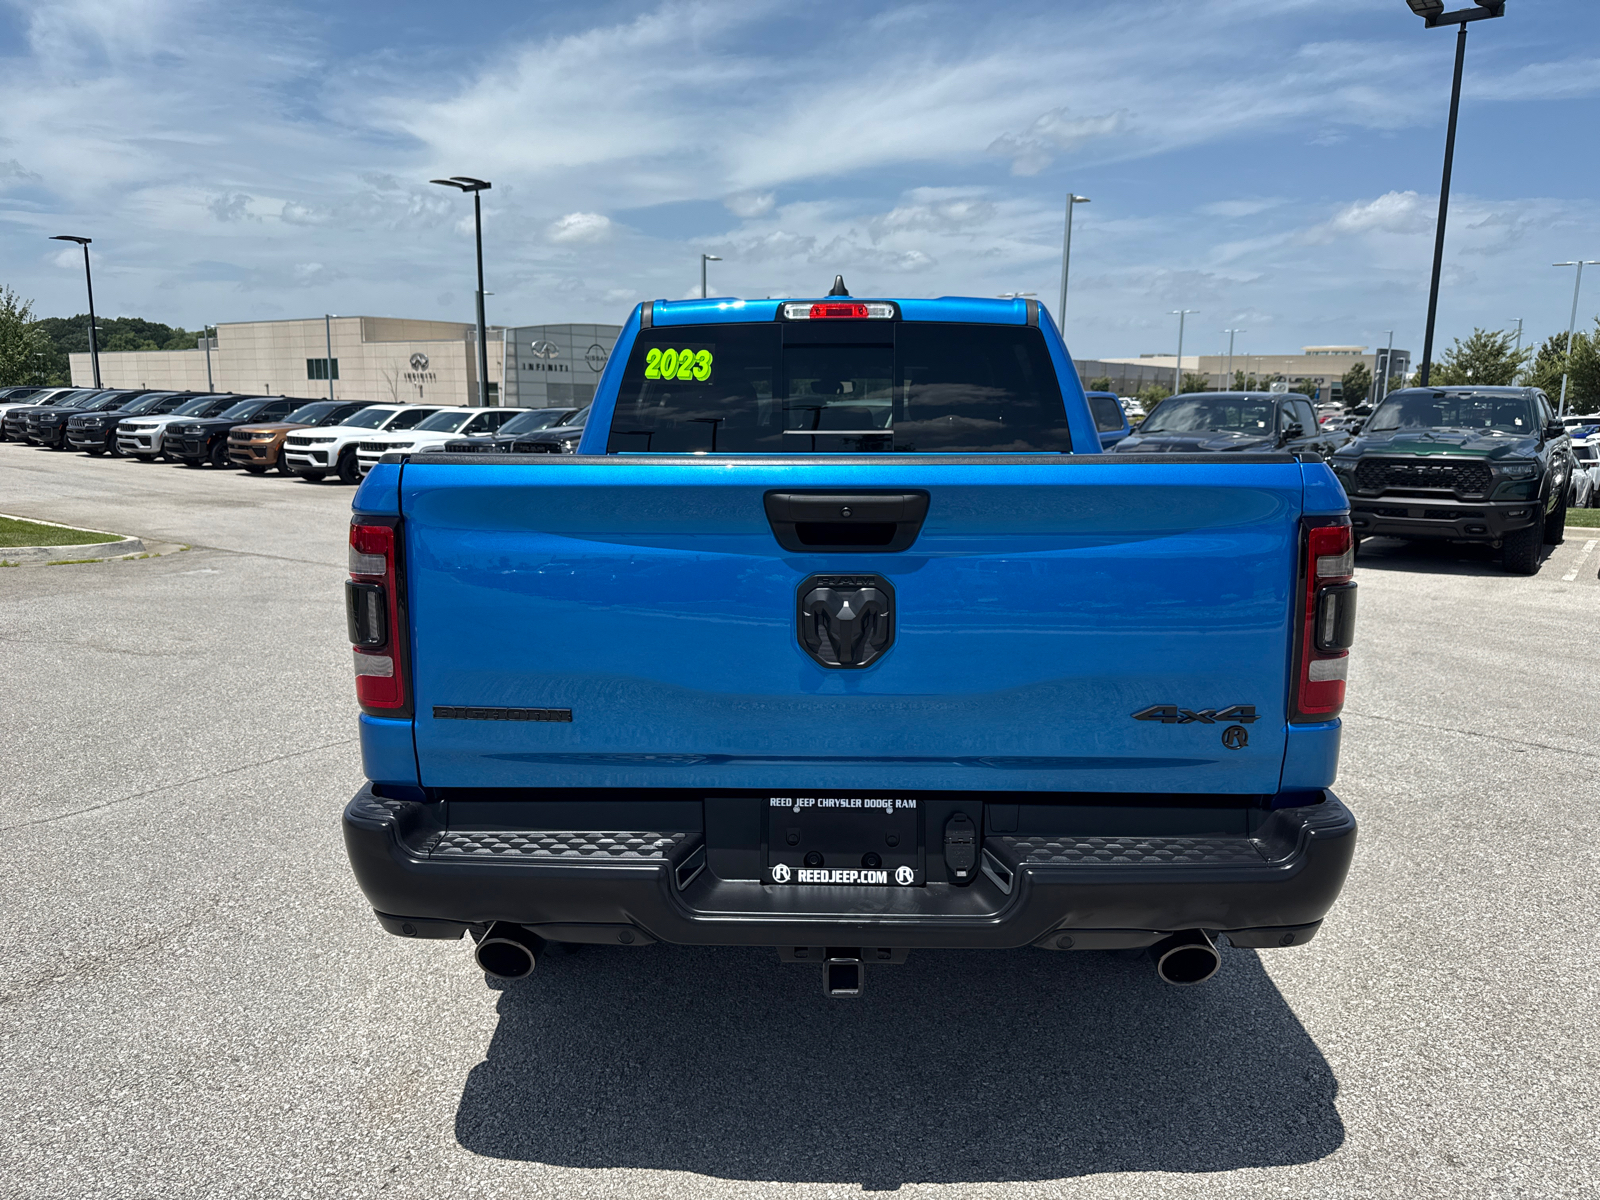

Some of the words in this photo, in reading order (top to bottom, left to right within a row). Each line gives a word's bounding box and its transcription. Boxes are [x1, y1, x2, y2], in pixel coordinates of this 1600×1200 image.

[523, 363, 568, 372] INFINITI
[644, 348, 713, 382] 2023
[817, 576, 875, 585] RAM
[770, 798, 792, 807] REED
[795, 798, 815, 807] JEEP
[817, 799, 862, 808] CHRYSLER
[864, 799, 893, 809] DODGE
[895, 800, 917, 809] RAM
[798, 870, 887, 884] REEDJEEP.COM
